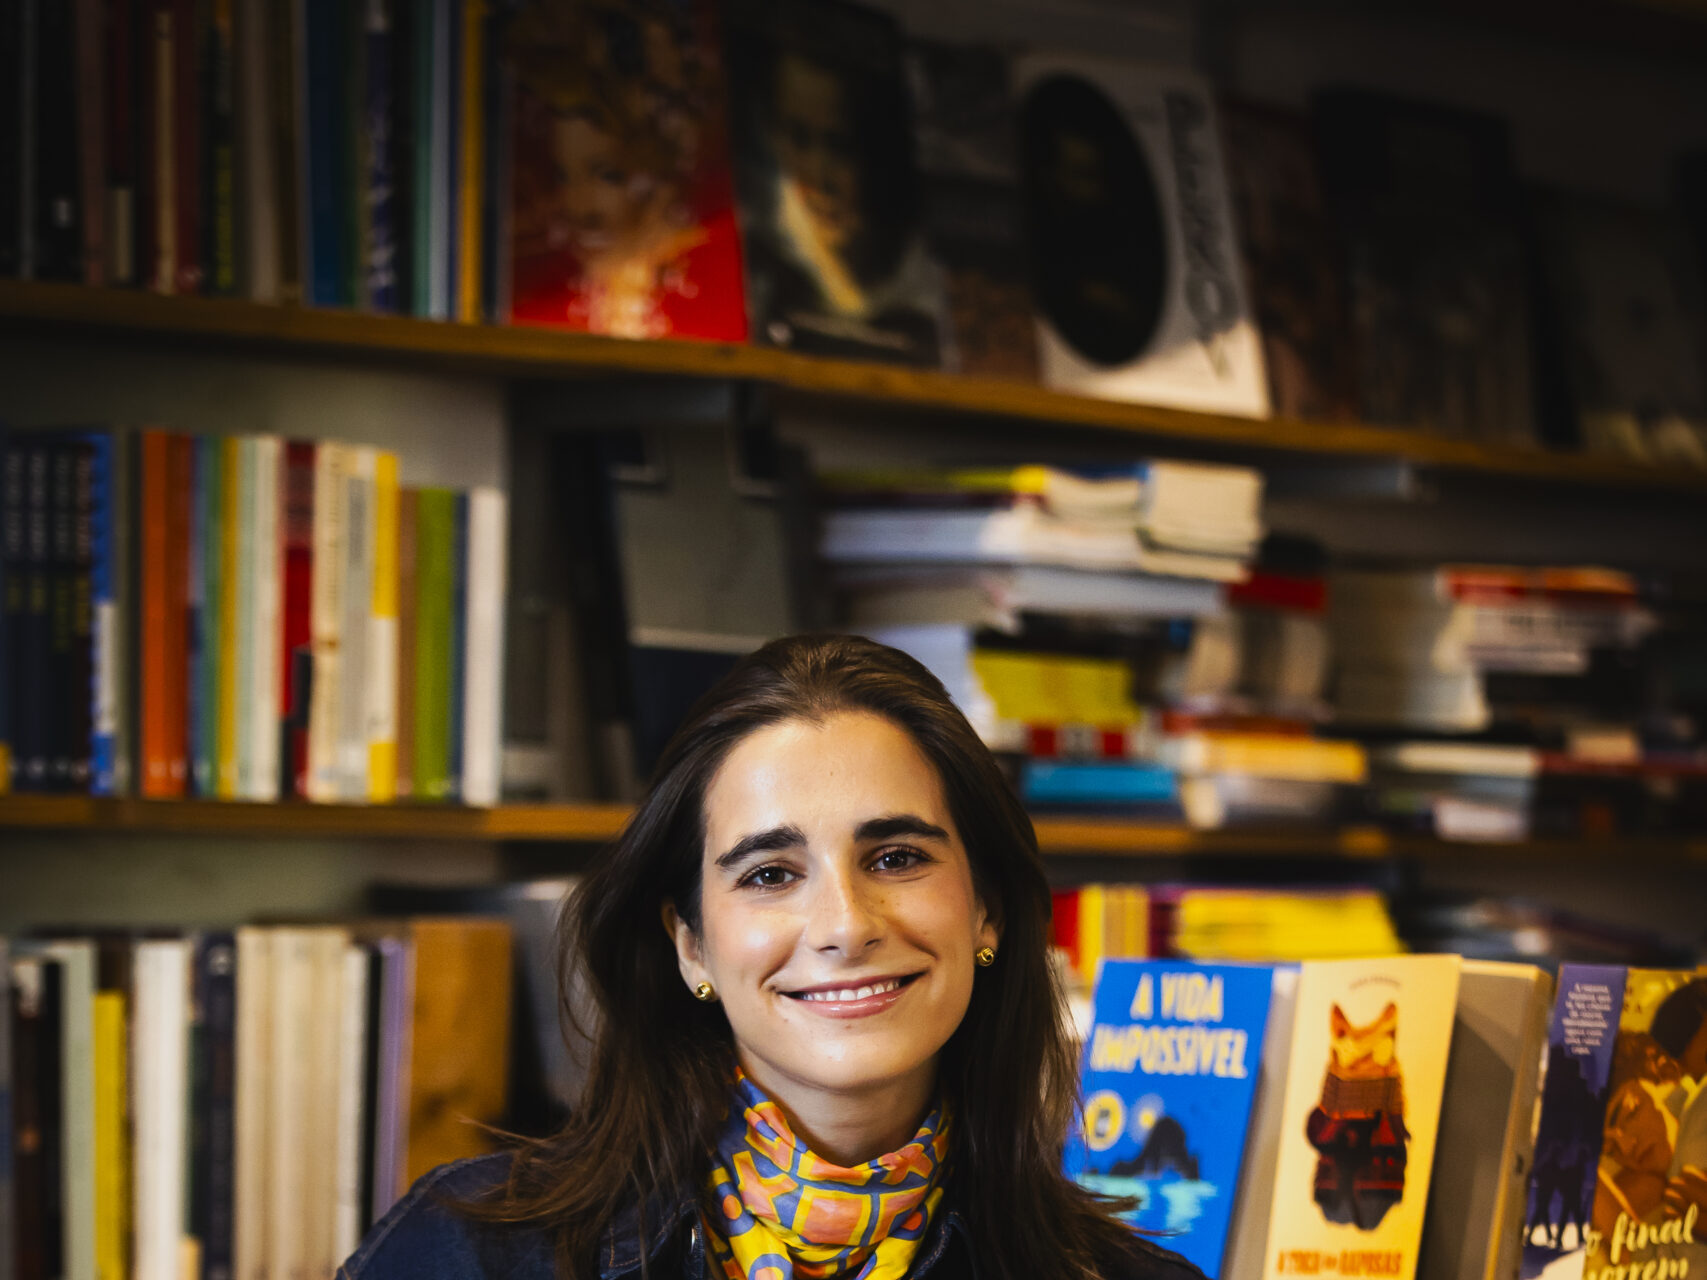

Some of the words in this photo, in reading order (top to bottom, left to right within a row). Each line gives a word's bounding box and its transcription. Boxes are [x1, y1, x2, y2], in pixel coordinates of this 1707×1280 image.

[1130, 972, 1154, 1020] A
[1161, 972, 1224, 1023] VIDA
[1610, 1202, 1698, 1265] final
